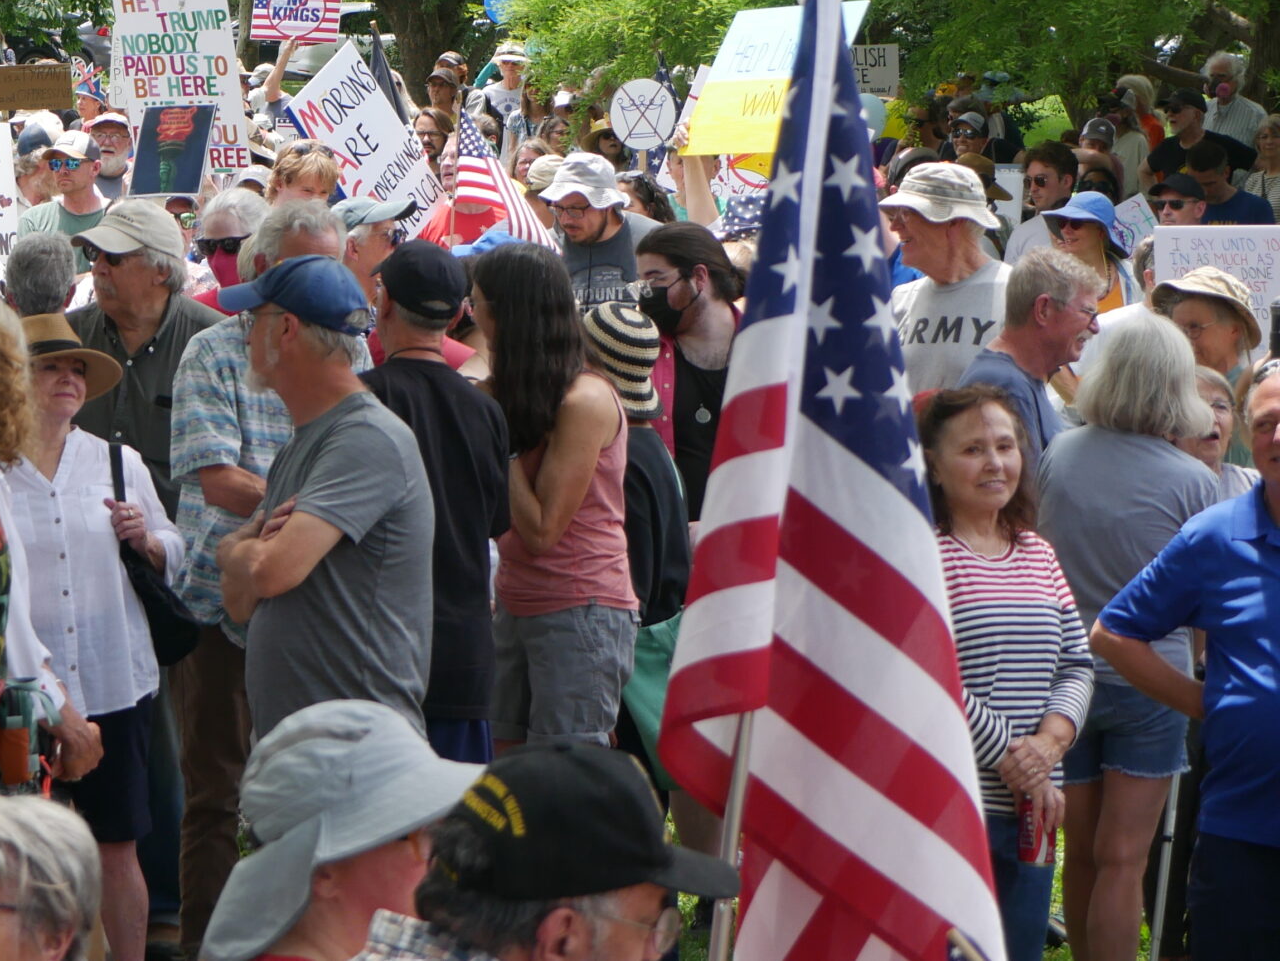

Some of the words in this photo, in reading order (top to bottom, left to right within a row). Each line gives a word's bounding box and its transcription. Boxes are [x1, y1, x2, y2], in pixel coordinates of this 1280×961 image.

[272, 6, 320, 23] KINGS
[121, 32, 198, 56] NOBODY
[124, 55, 166, 76] PAID
[169, 54, 198, 75] US
[203, 55, 228, 76] TO
[134, 77, 160, 98] BE
[167, 75, 225, 97] HERE.
[297, 59, 377, 138] MORONS
[211, 124, 238, 145] OU
[209, 147, 249, 168] REE
[333, 122, 379, 186] ARE
[1171, 238, 1180, 252] I
[1190, 238, 1215, 251] SAY
[1222, 238, 1257, 251] UNTO
[1264, 238, 1280, 251] YO
[1170, 253, 1190, 265] IN
[1196, 253, 1209, 265] AS
[1214, 253, 1248, 265] MUCH
[1258, 253, 1274, 265] AS
[1241, 267, 1273, 280] DONE
